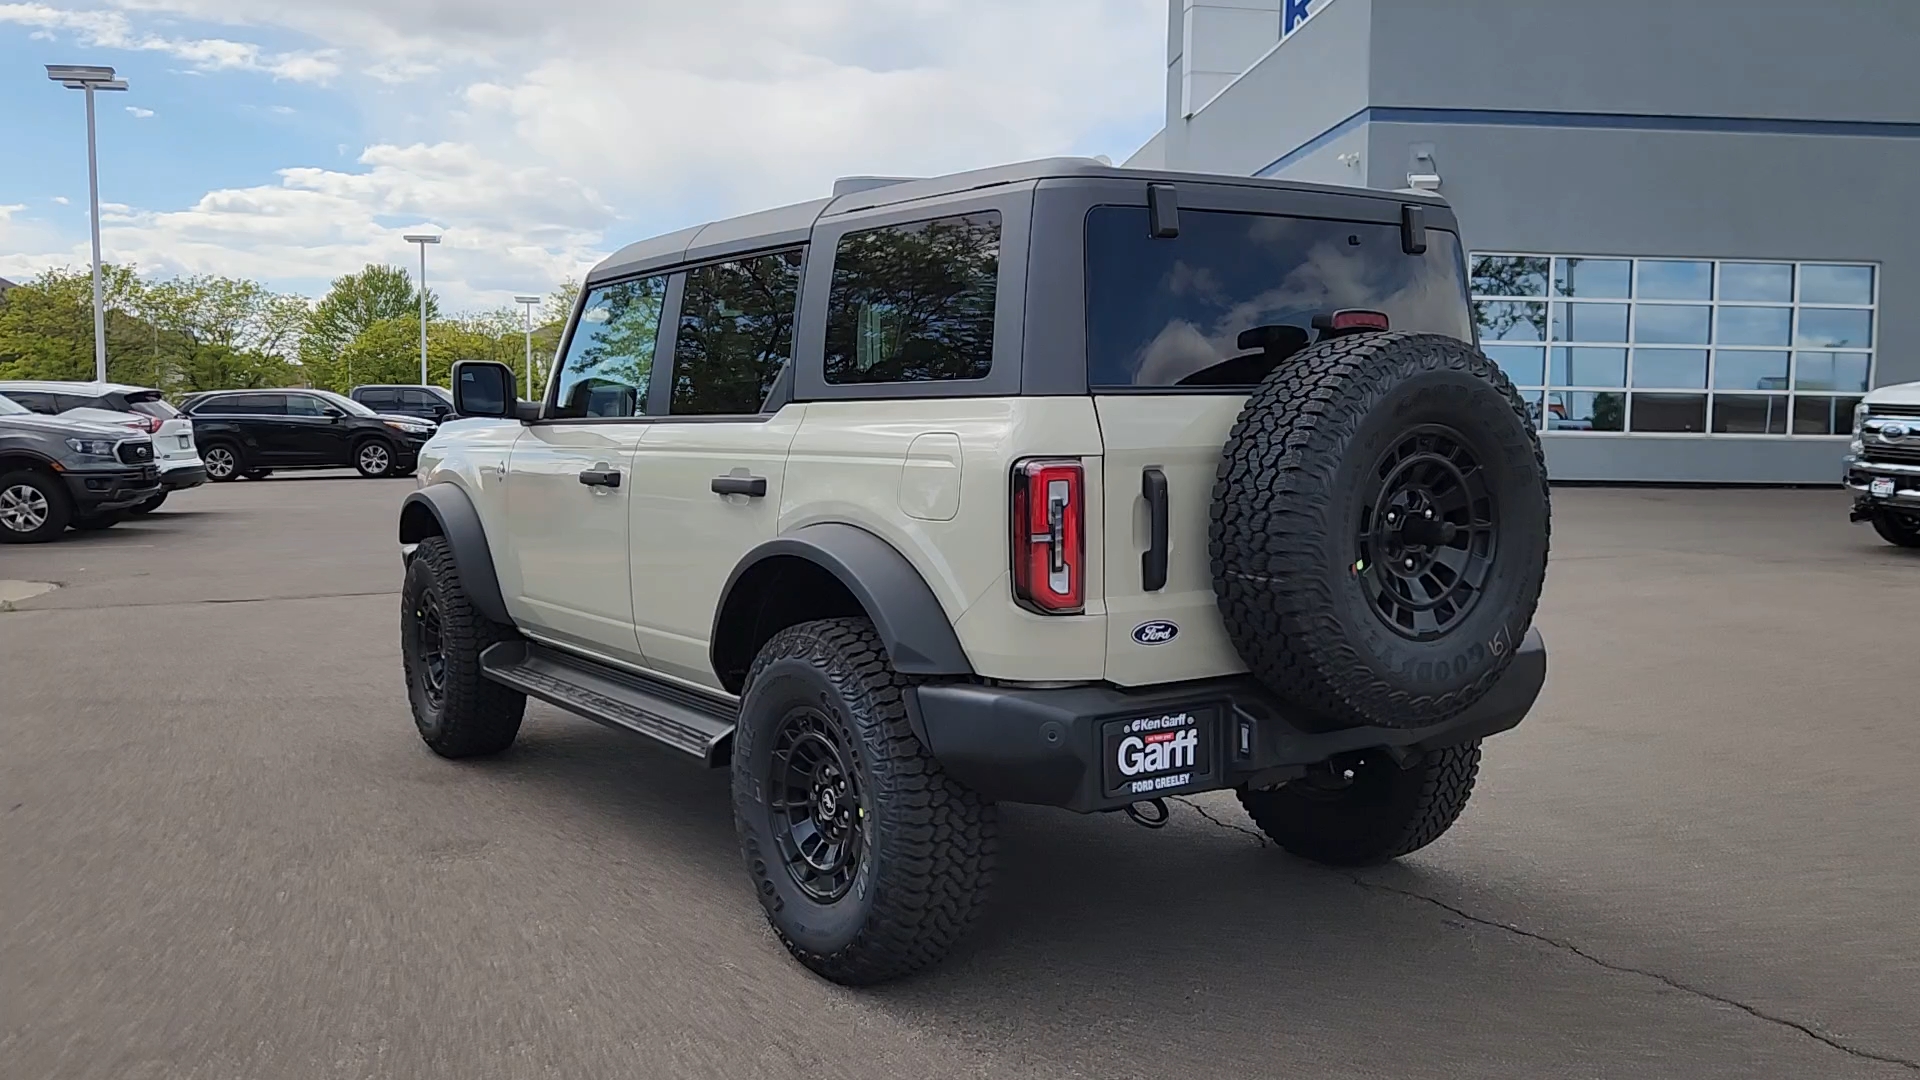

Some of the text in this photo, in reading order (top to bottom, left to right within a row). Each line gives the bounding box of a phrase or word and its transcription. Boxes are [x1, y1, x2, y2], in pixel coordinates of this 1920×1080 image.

[1141, 624, 1172, 641] Ford
[1141, 717, 1160, 731] Ken
[1161, 713, 1187, 728] Garff
[1117, 728, 1198, 776] Garff
[1131, 772, 1190, 793] FORD GREELEY
